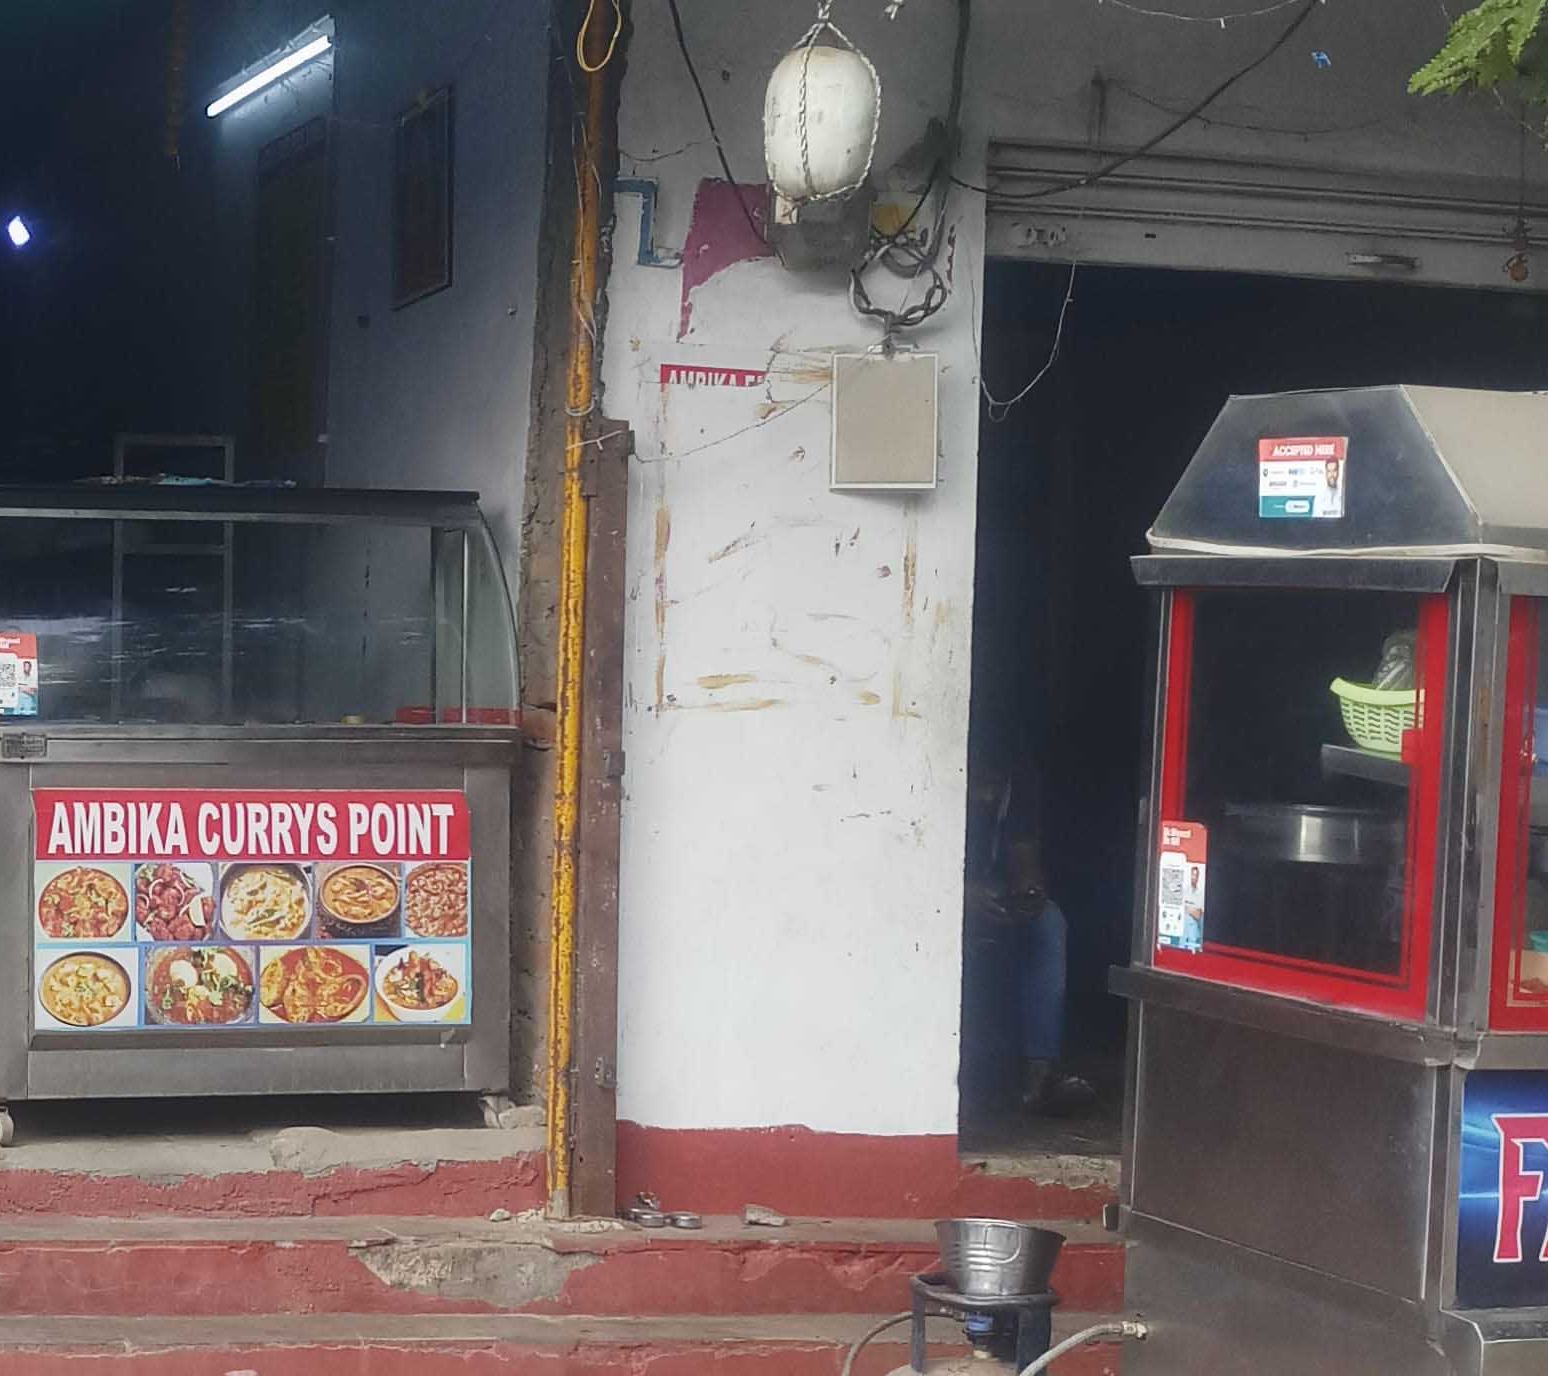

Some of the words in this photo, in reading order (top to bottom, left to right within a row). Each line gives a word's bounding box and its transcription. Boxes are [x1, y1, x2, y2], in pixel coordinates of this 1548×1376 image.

[47, 801, 189, 856] AMBIKA
[197, 802, 339, 857] CURRYS
[347, 802, 455, 857] POINT
